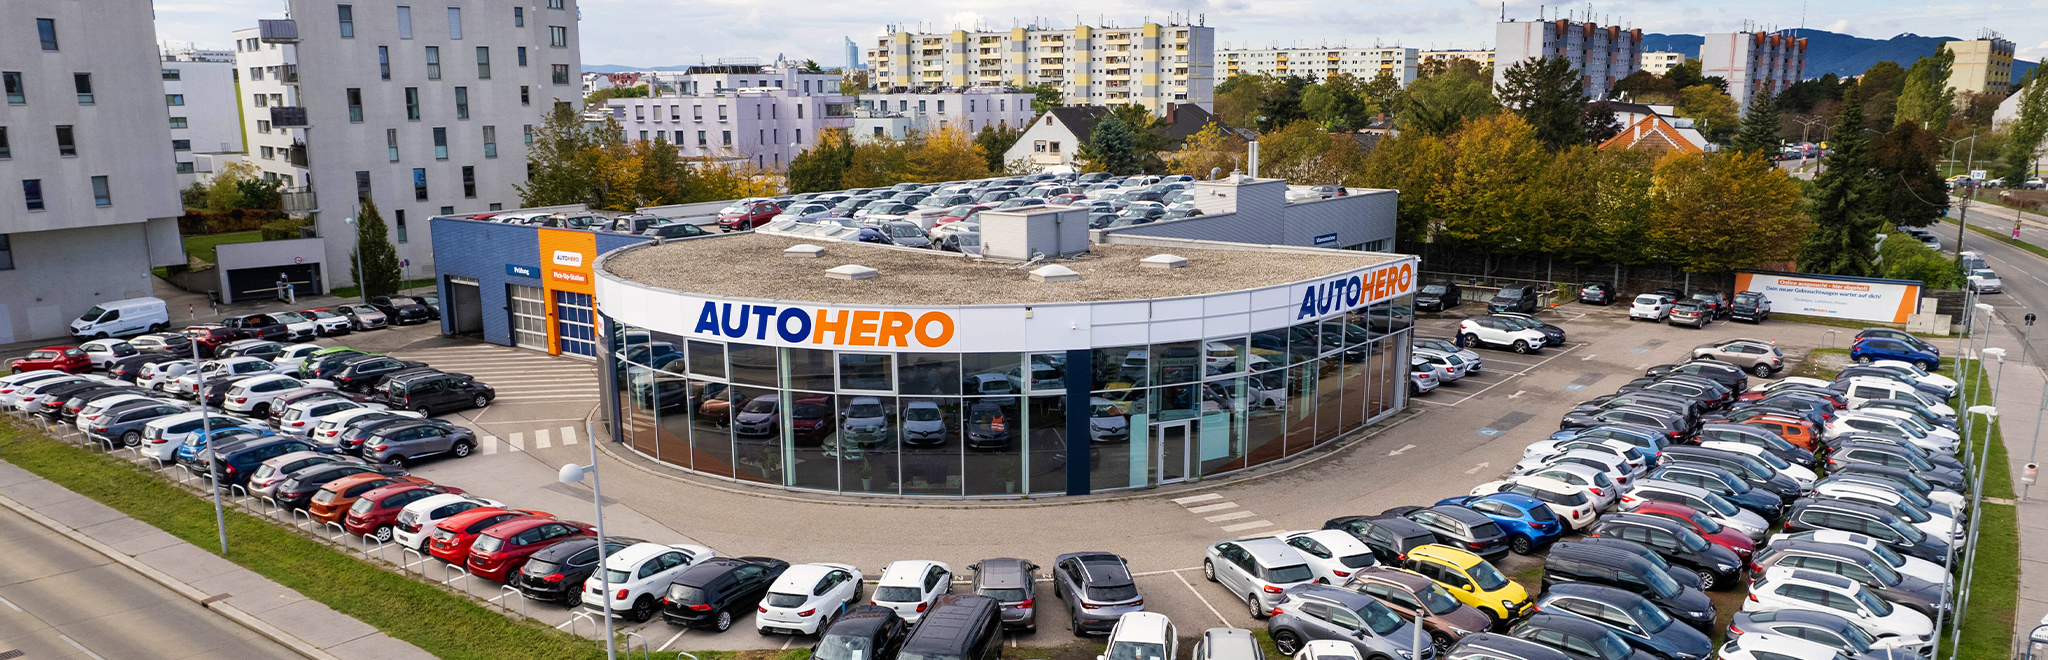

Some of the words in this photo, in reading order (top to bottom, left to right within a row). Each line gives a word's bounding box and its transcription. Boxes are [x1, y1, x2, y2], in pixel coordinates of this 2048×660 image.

[513, 266, 530, 276] Prüfung
[553, 271, 585, 282] Pick-Up-Station
[1297, 263, 1412, 320] AUTOHERO
[1794, 288, 1838, 297] Gebrauchtwagen
[694, 301, 955, 348] AUTOHERO
